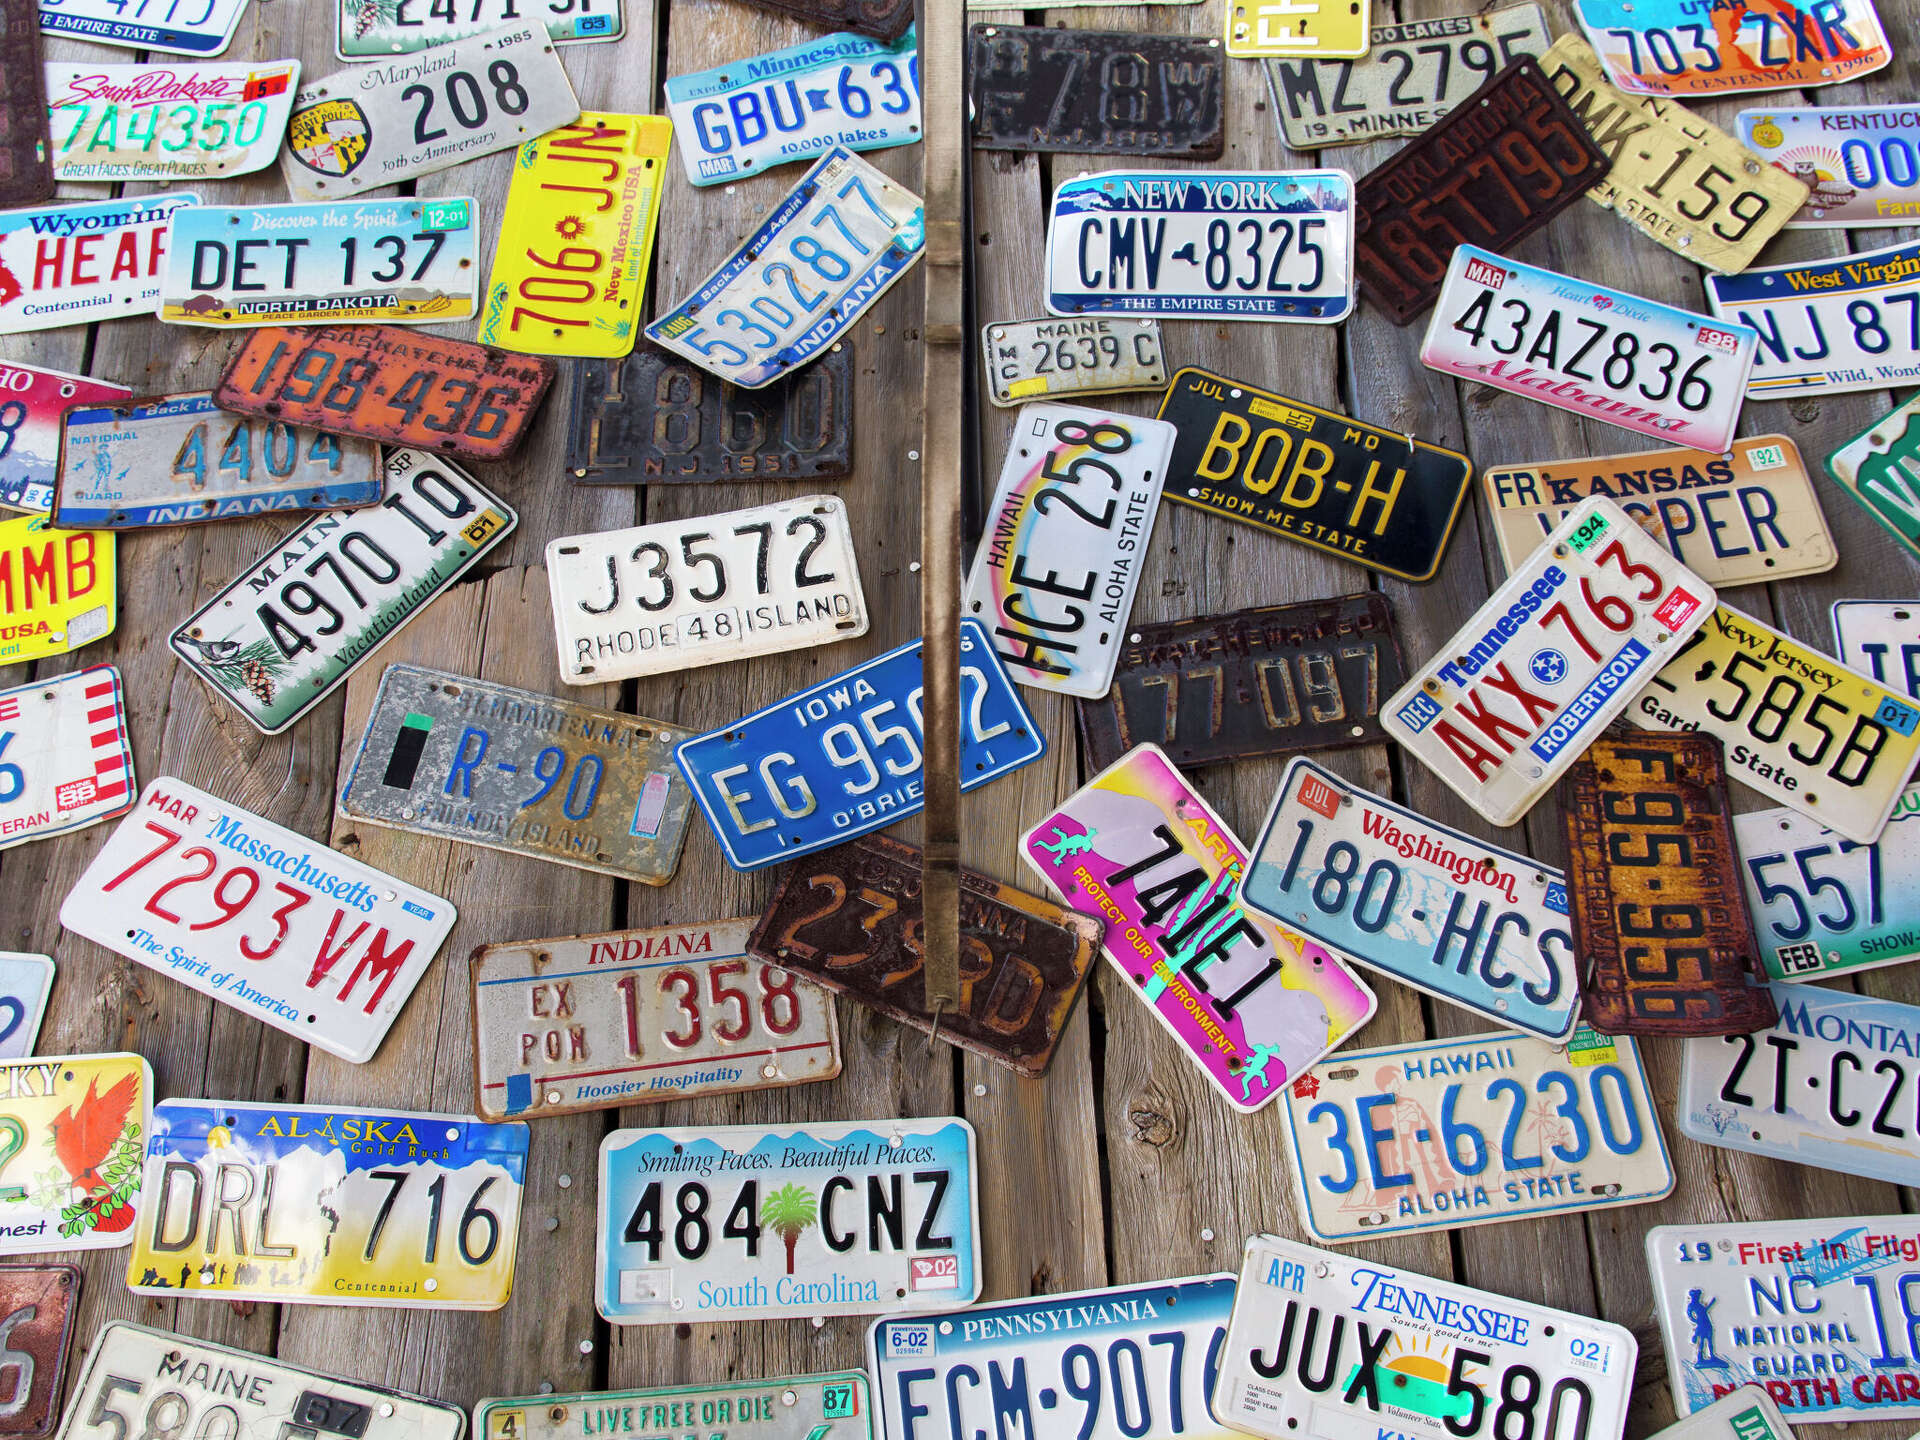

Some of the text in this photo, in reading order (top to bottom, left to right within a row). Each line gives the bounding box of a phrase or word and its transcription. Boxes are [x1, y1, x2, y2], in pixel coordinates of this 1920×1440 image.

[1681, 0, 1748, 15] UTAH
[54, 16, 159, 42] EMPIRE STATE
[498, 30, 532, 49] 1985
[1402, 18, 1471, 40] LAKES
[1608, 1, 1860, 75] 703 ZXR
[360, 50, 458, 90] Maryland
[747, 40, 875, 80] Minnesota
[1691, 54, 1875, 90] CENTENNIAL 1996
[401, 59, 530, 145] 208
[1279, 60, 1367, 119] MZ
[62, 101, 268, 152] 7A4350
[692, 79, 807, 155] GBU
[839, 128, 888, 144] lakes
[383, 131, 497, 174] 50th Anniversary
[1385, 76, 1545, 201] OKLAHOMA
[62, 160, 168, 176] GREAT GREAT
[700, 159, 733, 178] MAR
[1123, 181, 1280, 211] NEW YORK
[251, 207, 399, 231] Discover the Spirit
[428, 209, 464, 229] 12-01
[604, 165, 643, 303] New Mexico USA
[1626, 199, 1681, 238] STATE
[191, 233, 446, 291] DET 137
[684, 176, 898, 368] 53D2877
[1078, 217, 1325, 293] CMV 8325
[509, 246, 604, 333] 706
[700, 270, 733, 303] Back
[1466, 262, 1504, 289] MAR
[1552, 285, 1594, 305] Heart
[1785, 270, 1845, 292] West
[23, 294, 113, 315] Centennial
[238, 293, 399, 314] NORTH DAKOTA
[262, 308, 376, 320] PEACE STATE
[794, 264, 894, 359] INDIANA
[1122, 298, 1276, 312] THE EMPIRE STATE
[1036, 320, 1111, 338] MAINE
[1738, 305, 1831, 366] NJ
[1032, 333, 1155, 374] 2639 C
[1453, 289, 1714, 412] 43AZ836
[1189, 379, 1225, 402] JUL
[1827, 367, 1874, 384] Wild,
[146, 400, 189, 416] Back
[1452, 358, 1694, 433] Alabama
[71, 432, 139, 446] NATIONAL
[1344, 428, 1380, 450] MO
[388, 452, 415, 478] SEP
[1547, 460, 1736, 505] KANSAS
[74, 491, 123, 502] GUARD
[147, 494, 300, 523] INDIANA
[1493, 472, 1540, 508] FR
[986, 492, 1026, 569] HAWAII
[1199, 488, 1368, 553] SHOW-ME STATE
[1579, 511, 1605, 542] 94
[256, 470, 477, 662] 4970 IQ
[577, 514, 836, 616] J3572
[994, 419, 1132, 677] HCE 258
[1099, 490, 1149, 624] ALOHA STATE
[1, 621, 52, 642] USA
[334, 567, 443, 667] Vacationland
[574, 593, 852, 664] RHODE 48 ISLAND
[1438, 565, 1567, 689] Tennessee
[1431, 538, 1664, 784] AKX 763
[1714, 609, 1765, 651] New
[1759, 637, 1843, 693] Jersey
[796, 678, 877, 727] IOWA
[1400, 695, 1434, 734] DEC
[1538, 646, 1642, 755] ROBERTSON
[444, 726, 605, 821] R-90
[1731, 745, 1799, 791] State
[147, 789, 199, 826] MAR
[711, 752, 817, 836] EG
[1304, 780, 1331, 809] JUL
[205, 815, 378, 912] Massachusetts
[1363, 808, 1518, 904] Washington
[1748, 841, 1883, 940] 557
[101, 821, 416, 1015] 7293 VM
[1279, 819, 1574, 1006] 180-HCS
[587, 931, 713, 966] INDIANA
[1072, 864, 1237, 1056] PROTECT OUR ENVIRONMENT
[1778, 943, 1820, 974] FEB
[132, 928, 300, 1022] The Spirit of America
[616, 961, 801, 1060] 1358
[576, 1066, 743, 1100] Hoosier Hospitality
[1404, 1048, 1514, 1081] HAWAII
[256, 1114, 421, 1147] ALASKA
[1307, 1065, 1643, 1194] 3E-6230
[351, 1141, 450, 1160] Gold Rush
[638, 1142, 937, 1177] Smiling Faces. Beautiful Places.
[153, 1161, 500, 1266] DRL 716
[1399, 1172, 1585, 1217] ALOHA STATE
[623, 1170, 953, 1262] 484 CNZ
[935, 1258, 957, 1275] 02
[1738, 1242, 1806, 1266] First
[334, 1277, 417, 1294] Centennial
[698, 1273, 879, 1309] South Carolina
[1267, 1257, 1306, 1294] APR
[1748, 1273, 1823, 1317] NC
[962, 1298, 1160, 1342] PENNSYLVANIA
[1351, 1267, 1529, 1347] TENNESSEE
[1390, 1314, 1431, 1334] Sounds
[892, 1331, 928, 1348] 6-02
[1570, 1338, 1601, 1362] 02
[1732, 1323, 1858, 1346] NATIONAL
[1250, 1301, 1392, 1412] JUX
[1752, 1353, 1849, 1376] GUARD
[159, 1353, 273, 1407] MAINE
[824, 1388, 851, 1411] 87
[583, 1396, 774, 1435] LIVE FREE OR DIE
